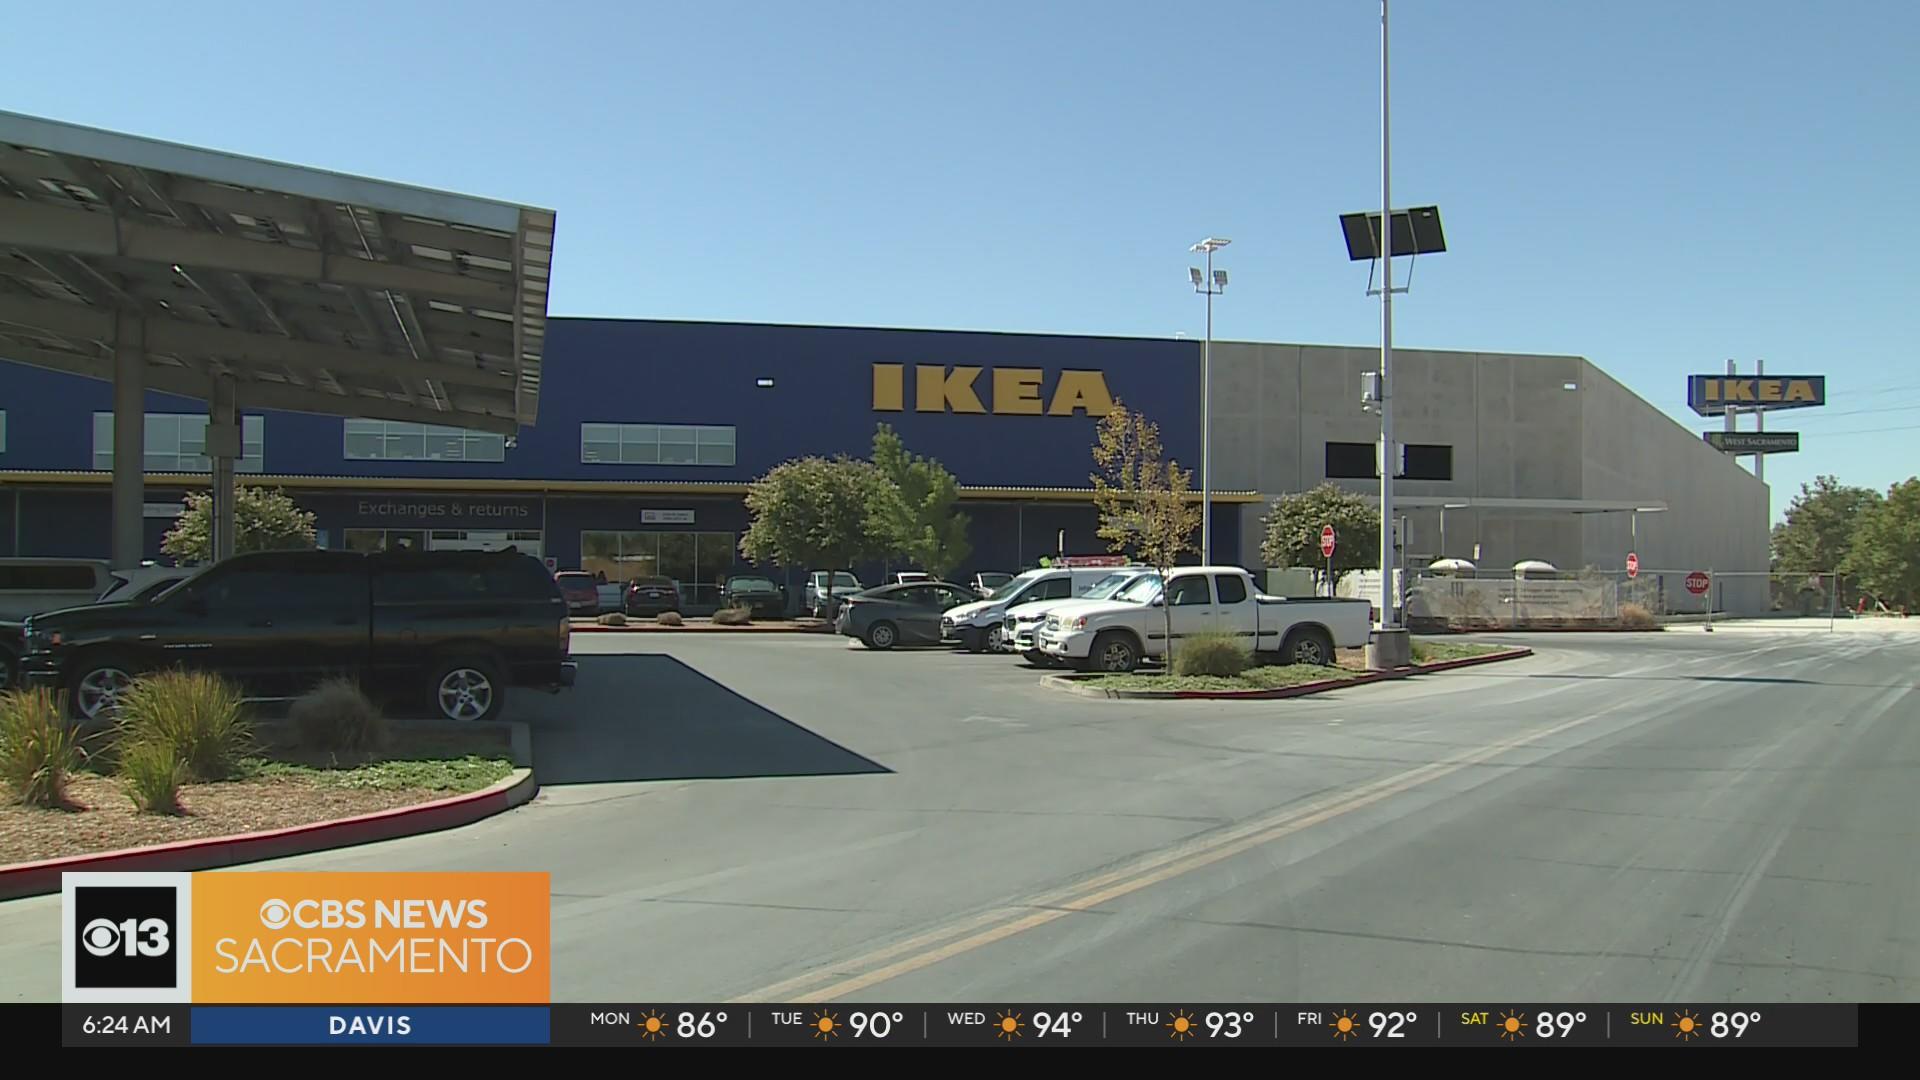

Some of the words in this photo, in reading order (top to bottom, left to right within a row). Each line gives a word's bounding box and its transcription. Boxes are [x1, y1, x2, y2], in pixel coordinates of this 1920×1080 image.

[872, 363, 1115, 417] IKEA
[1704, 379, 1817, 402] IKEA
[358, 501, 446, 519] Exchanges
[450, 502, 463, 517] &
[469, 503, 529, 517] returns
[1686, 578, 1709, 589] STOP
